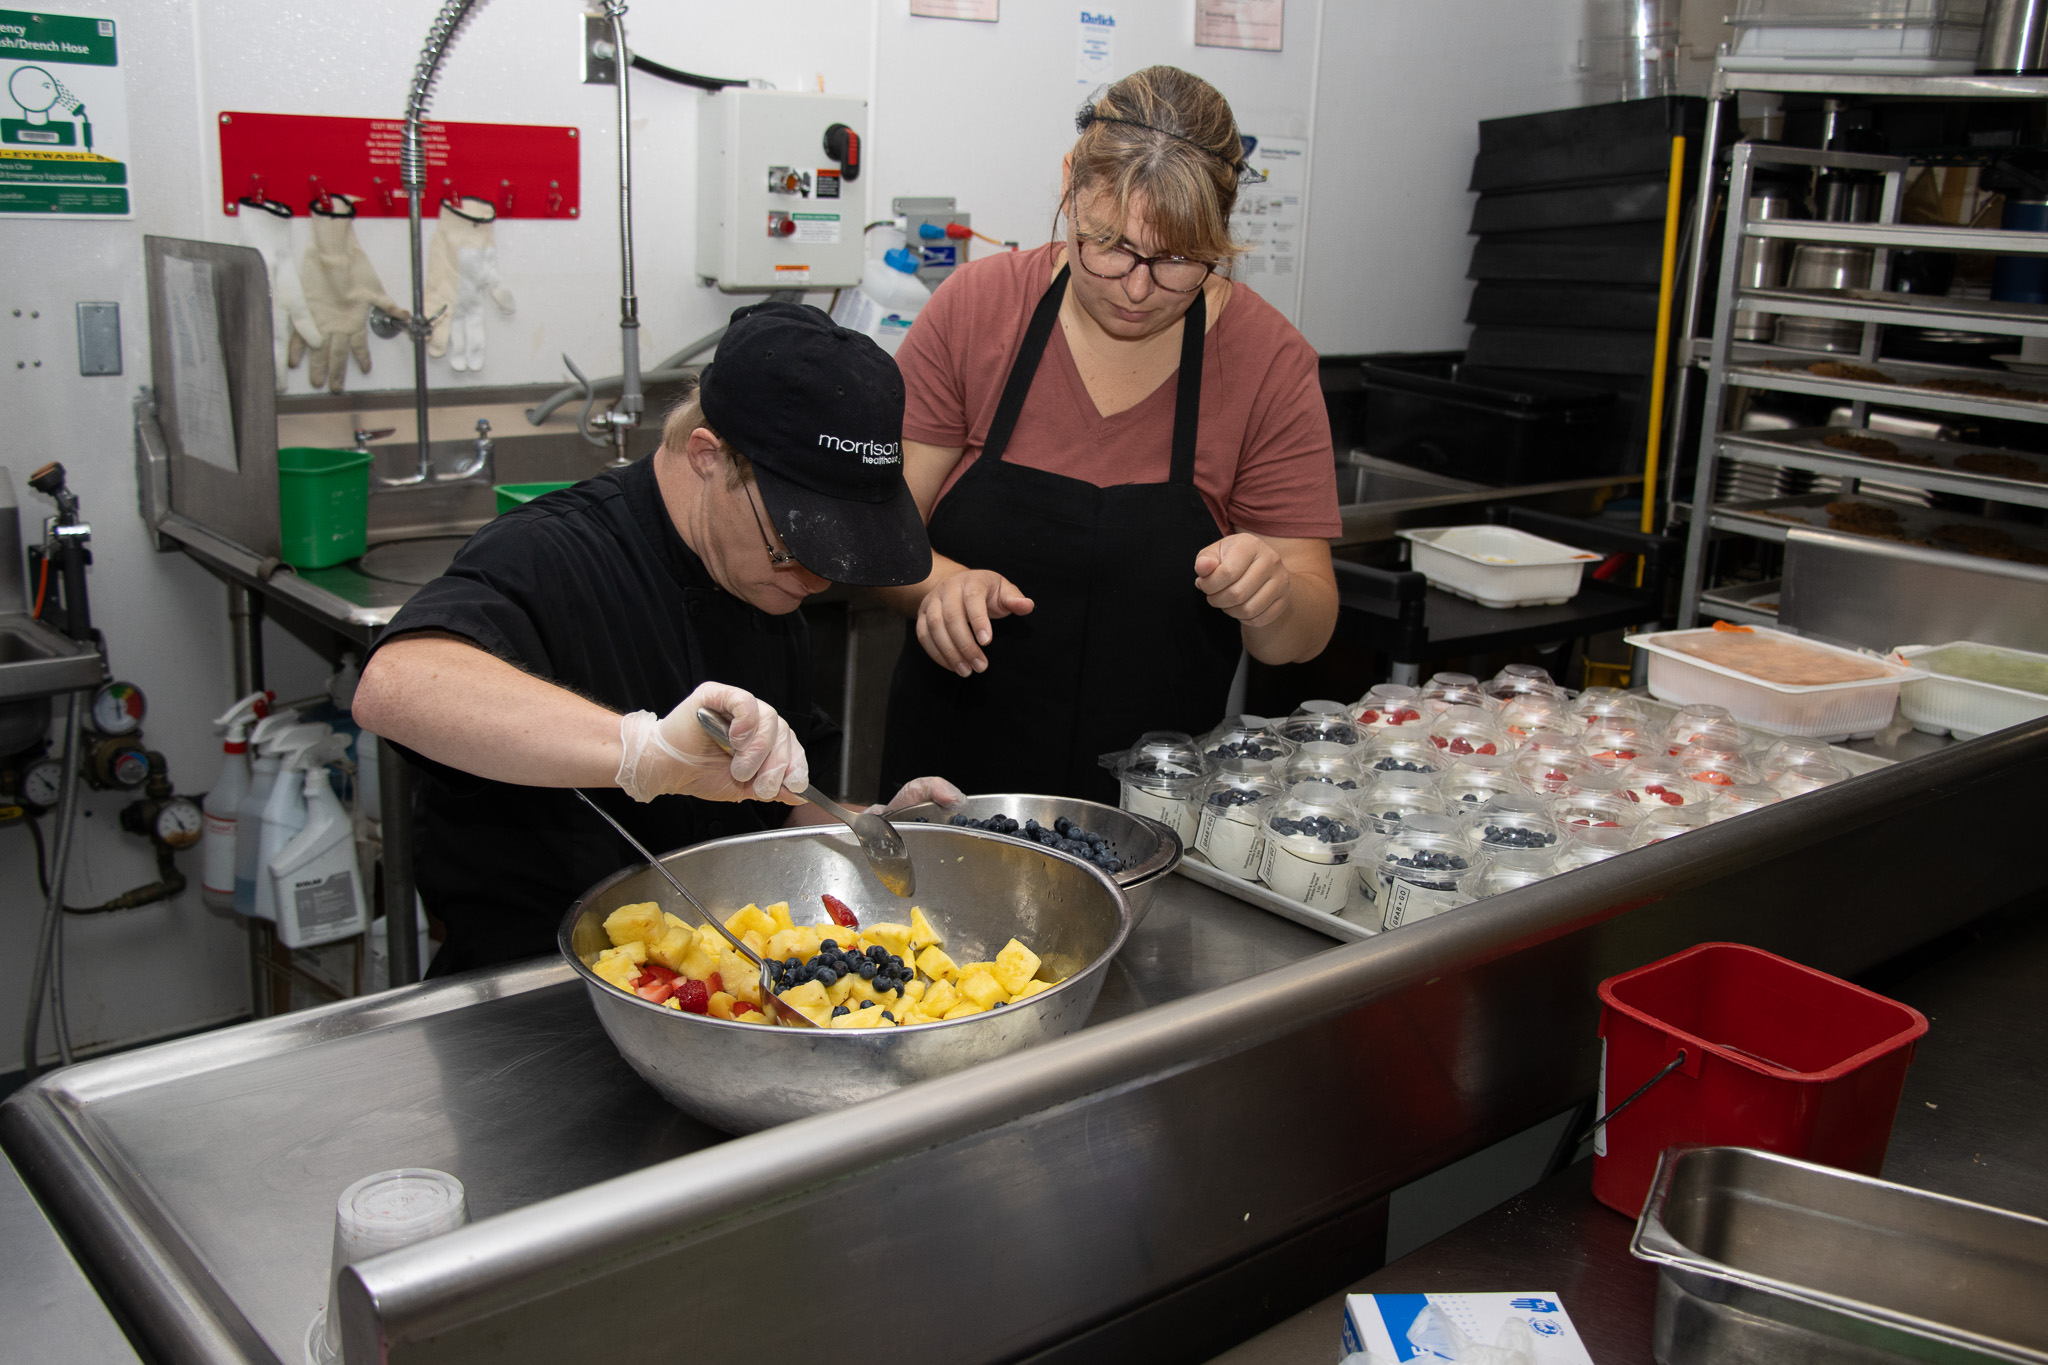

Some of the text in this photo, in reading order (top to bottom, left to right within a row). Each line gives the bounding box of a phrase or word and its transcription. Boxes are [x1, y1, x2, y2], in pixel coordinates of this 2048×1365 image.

[1081, 11, 1115, 27] Ehrlich
[0, 24, 26, 37] ency
[0, 37, 90, 55] sh/Drench Hose
[13, 152, 85, 161] EYEWASH
[819, 434, 899, 456] morrison
[1393, 890, 1406, 925] GRAB GO
